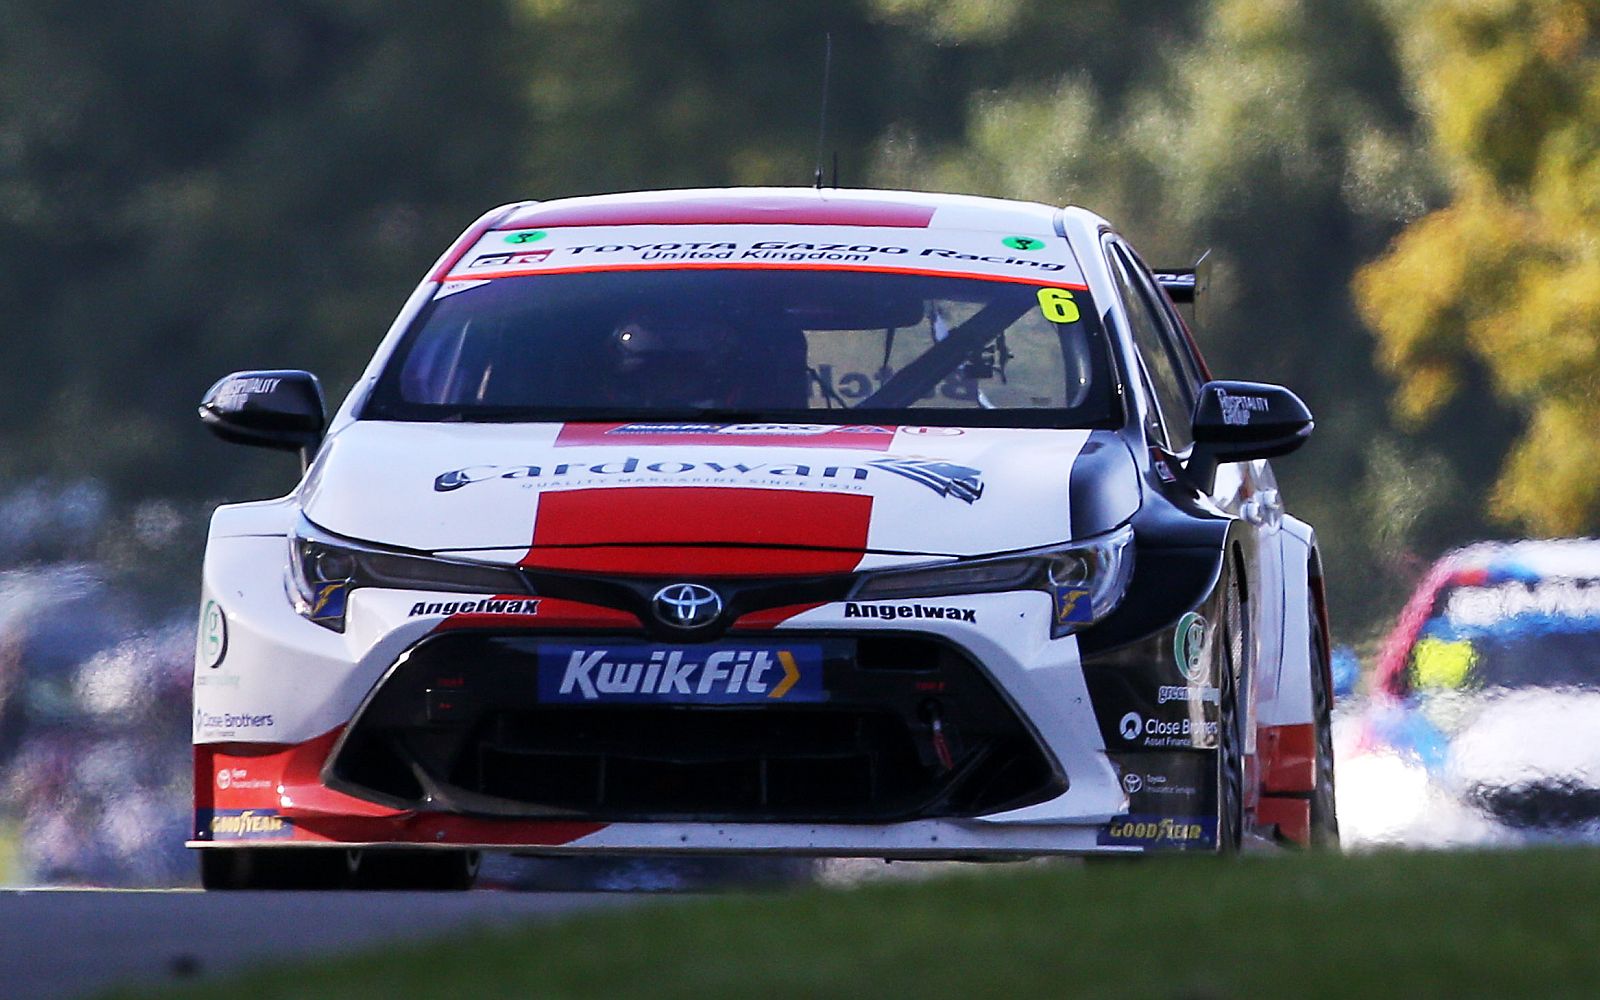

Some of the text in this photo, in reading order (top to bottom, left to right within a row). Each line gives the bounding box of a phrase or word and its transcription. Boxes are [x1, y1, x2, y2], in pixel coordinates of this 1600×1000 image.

[565, 241, 1066, 272] TOYOTA GAZOO Racing
[641, 250, 870, 261] United Kingdom
[1036, 287, 1081, 324] 6
[434, 456, 869, 493] Cardowan
[408, 598, 541, 618] Angelwax
[844, 602, 977, 624] Angelwax
[224, 713, 274, 728] Brothers
[1145, 718, 1181, 735] Close
